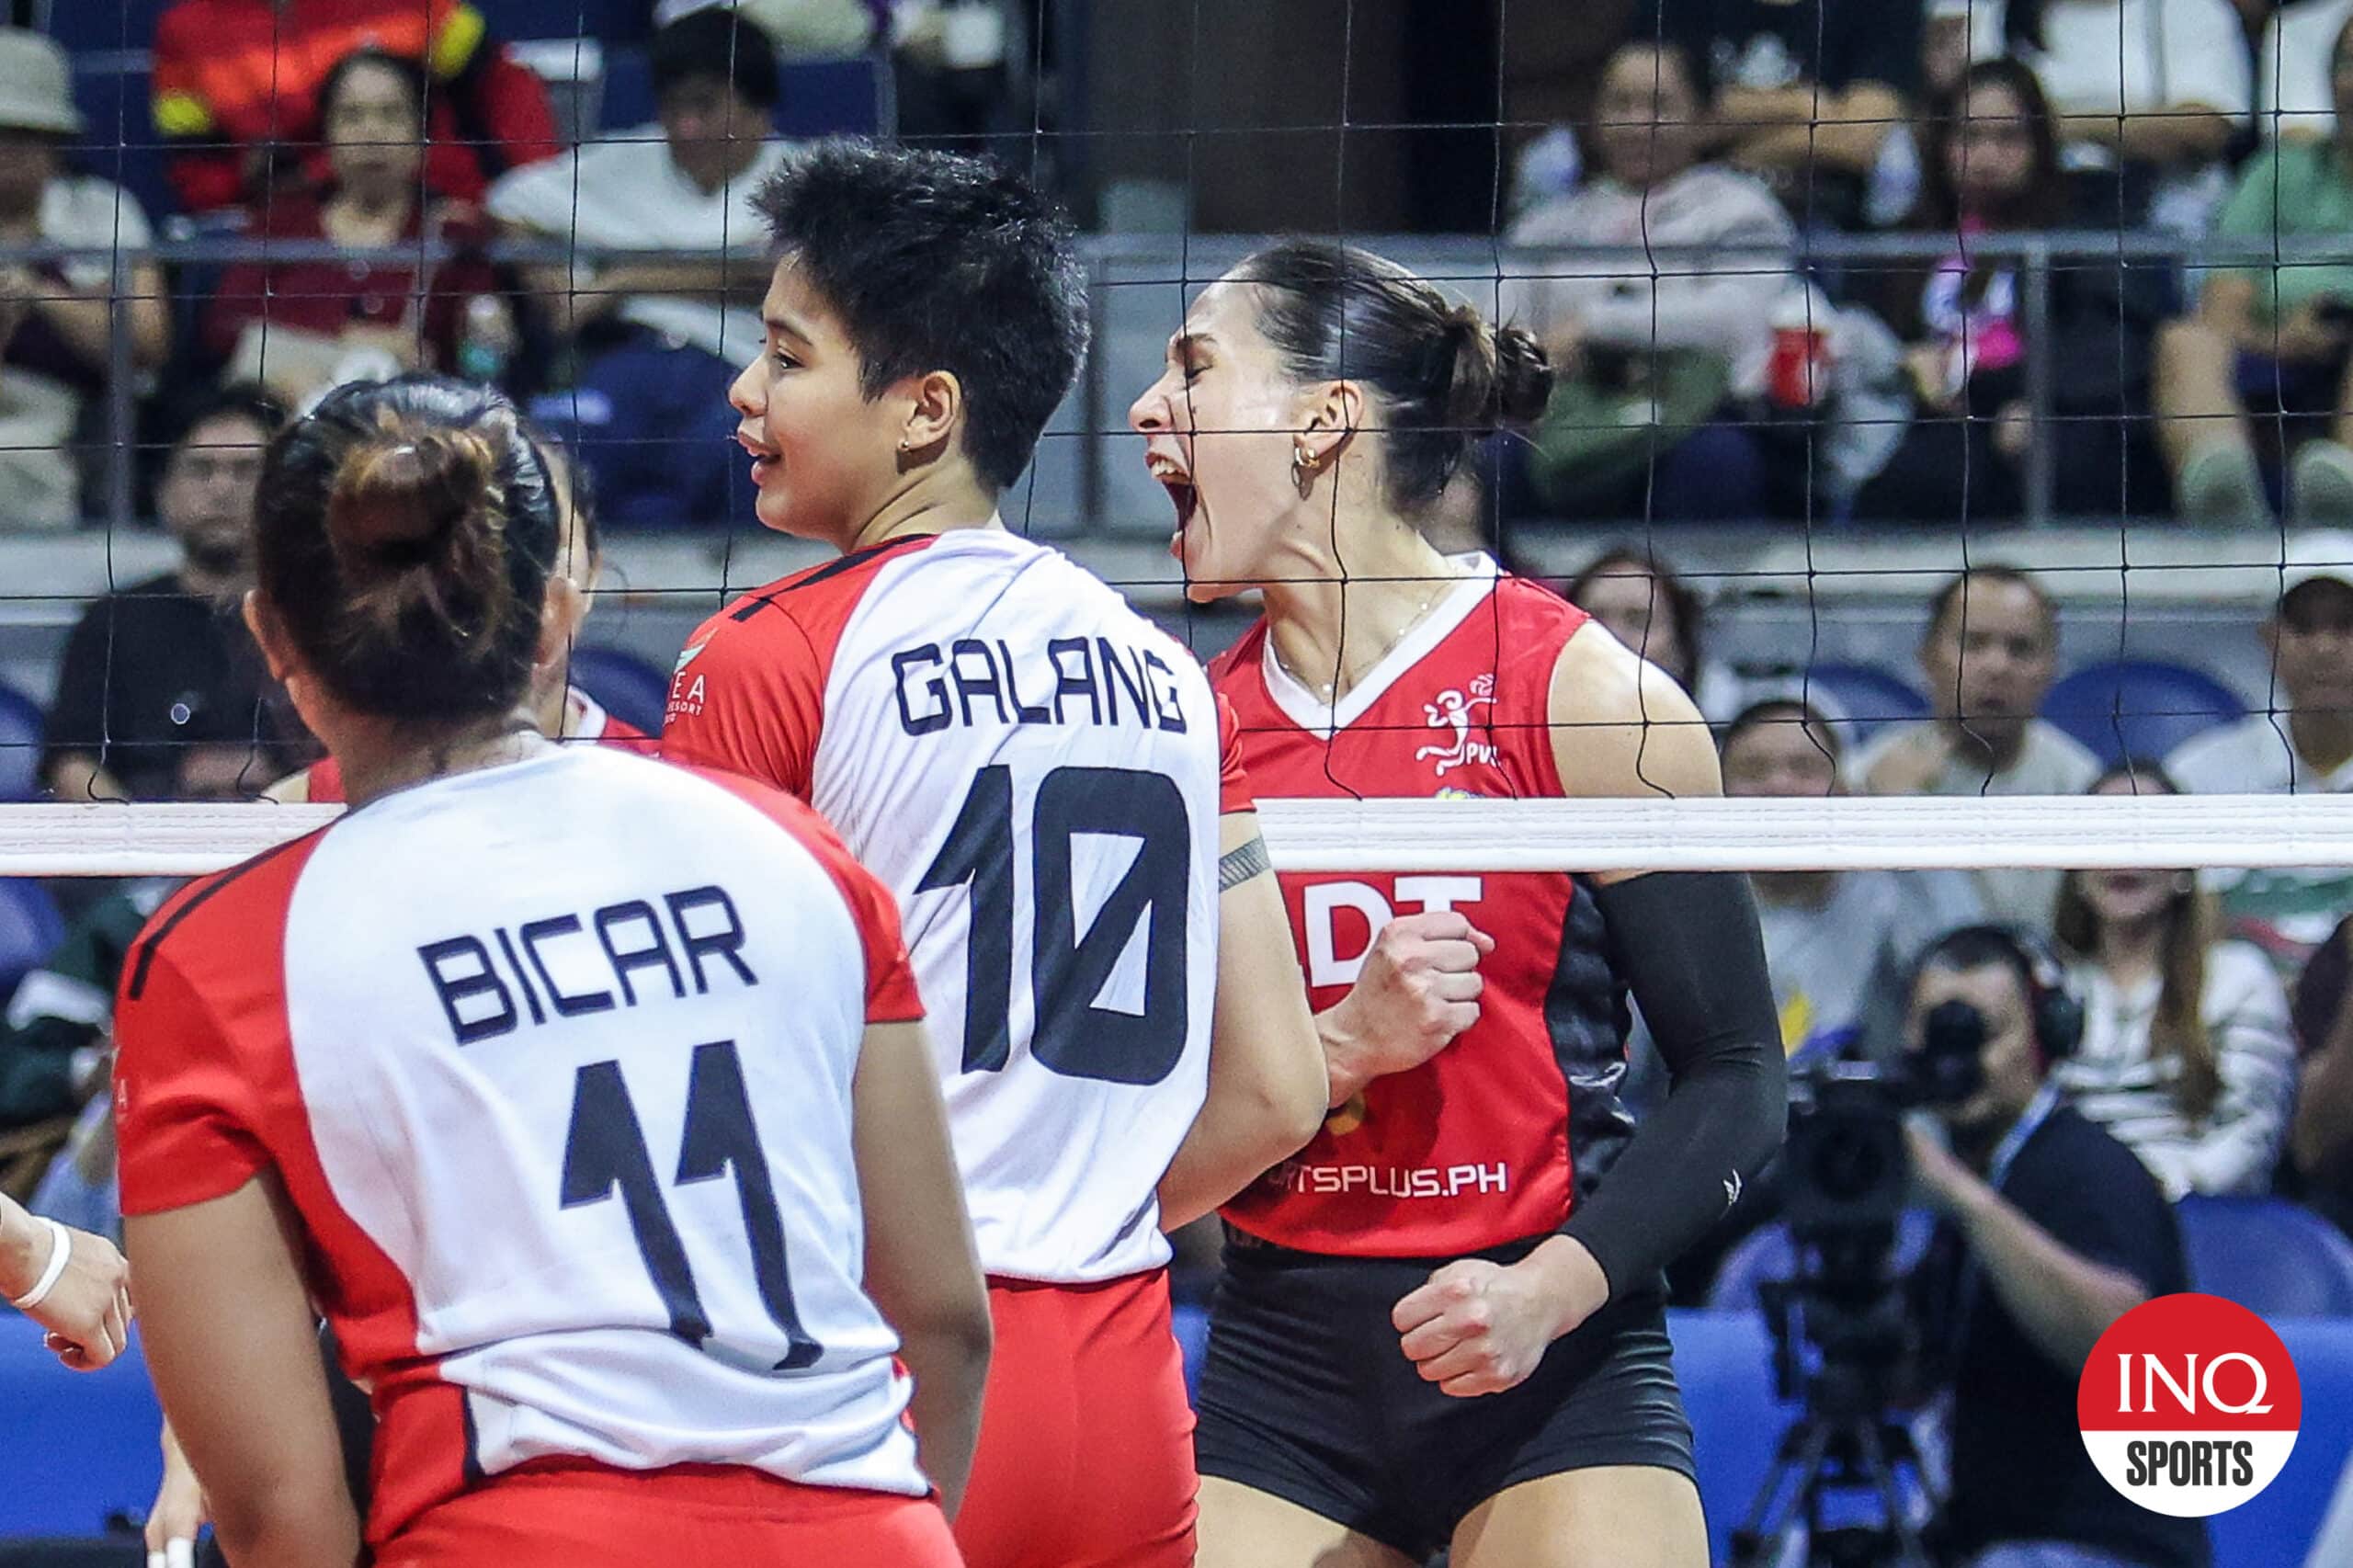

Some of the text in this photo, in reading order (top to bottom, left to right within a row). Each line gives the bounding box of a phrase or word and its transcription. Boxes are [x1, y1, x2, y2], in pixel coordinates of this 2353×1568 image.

[892, 636, 1187, 736] GALANG
[416, 884, 759, 1047] BICAR
[913, 764, 1190, 1085] 10
[559, 1039, 824, 1370] 11
